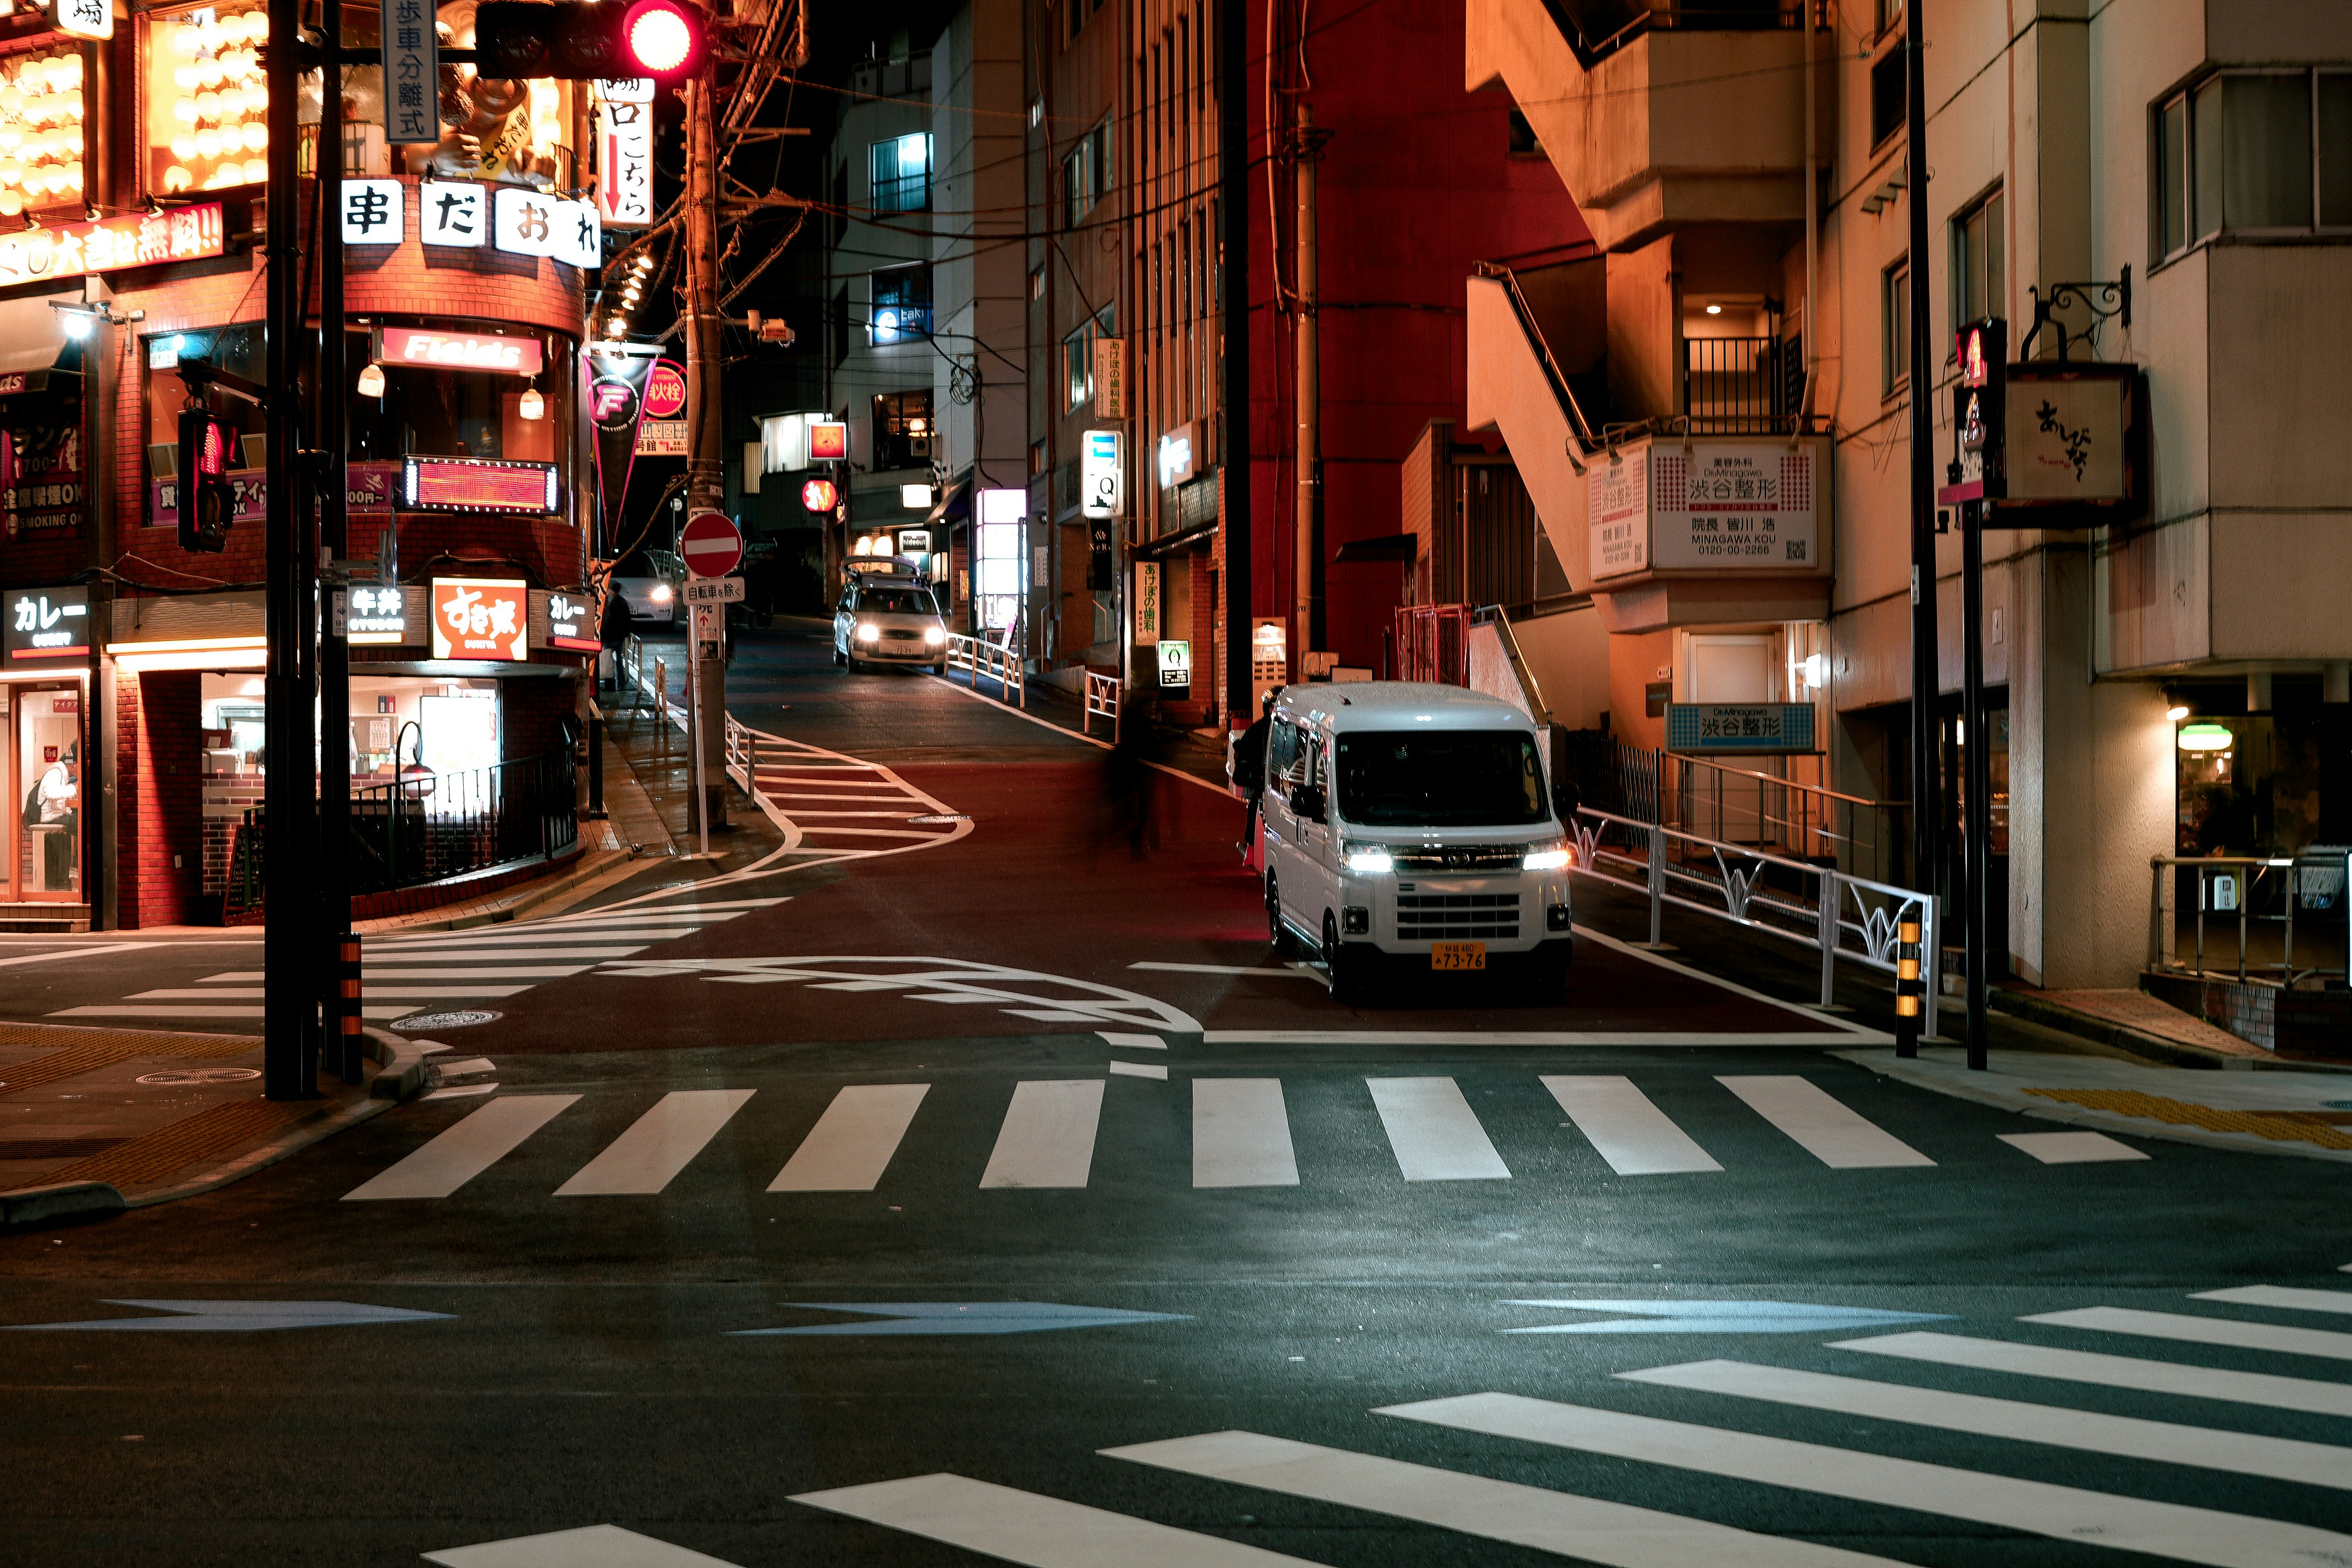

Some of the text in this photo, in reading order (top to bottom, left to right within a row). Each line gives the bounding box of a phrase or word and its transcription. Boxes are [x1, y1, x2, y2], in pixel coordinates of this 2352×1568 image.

[624, 136, 646, 217] こちら
[347, 185, 595, 252] 串だおれ
[404, 335, 521, 366] Fields
[1713, 456, 1753, 469] 美容外科
[1602, 483, 1632, 512] 渋谷整形
[1689, 478, 1777, 501] 渋谷整形
[19, 513, 66, 528] SMOKING
[1692, 516, 1775, 532] 院長 皆川 浩
[903, 538, 926, 546] hideout
[1692, 534, 1776, 545] MINAGAWA KOU
[1698, 544, 1769, 556] 0120-00-2266
[352, 589, 403, 616] 牛丼
[688, 582, 740, 601] 自転車を除く
[1144, 563, 1158, 633] あけぼの歯科
[15, 596, 87, 632] カレー
[442, 586, 517, 640] すき家
[550, 595, 585, 621] カレー
[1702, 717, 1781, 737] 渋谷整形
[1443, 953, 1483, 968] 73-76
